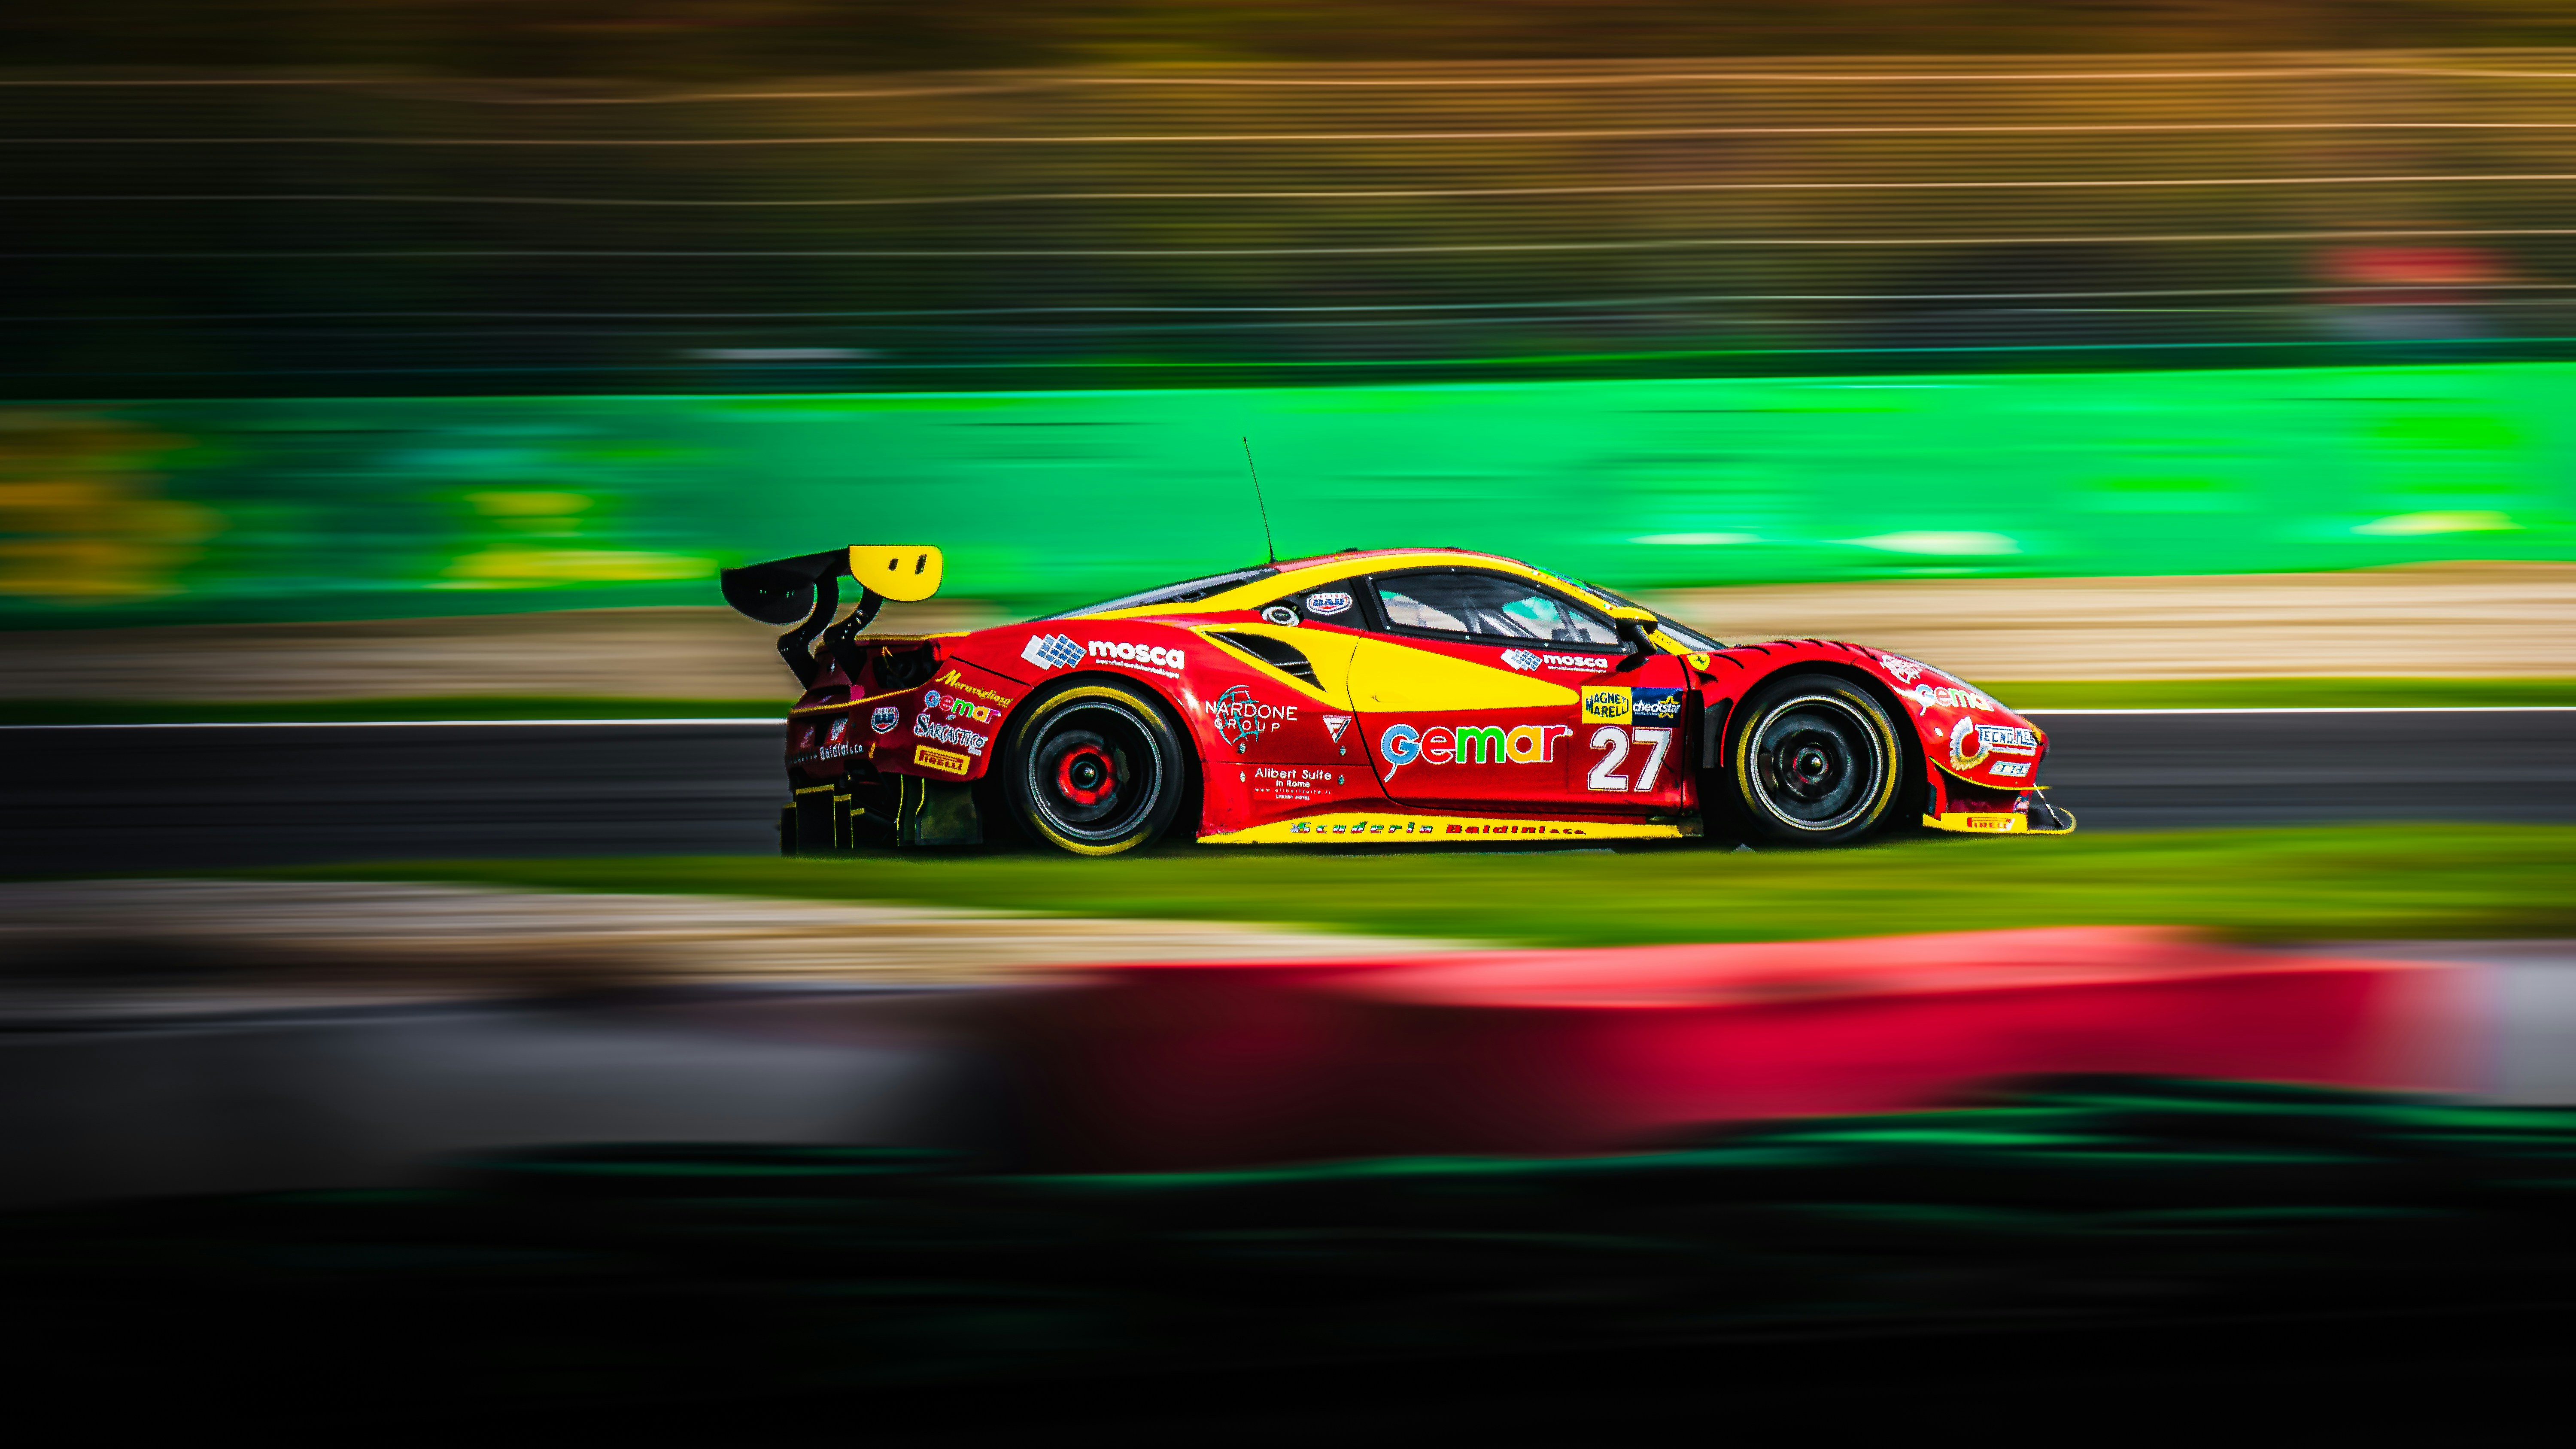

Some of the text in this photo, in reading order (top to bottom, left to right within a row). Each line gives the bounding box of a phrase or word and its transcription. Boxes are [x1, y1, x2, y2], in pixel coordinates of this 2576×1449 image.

[1088, 641, 1185, 670] mosca
[1543, 654, 1608, 668] mosca
[923, 690, 1002, 724] Gemar
[1586, 692, 1629, 707] MAGNETI
[1632, 700, 1681, 713] checkstar
[1205, 700, 1298, 721] NARDONE
[1214, 717, 1280, 732] GROUP
[919, 750, 964, 771] PIRELLI
[1380, 723, 1569, 783] Gemar
[1587, 726, 1672, 792] 27
[1255, 768, 1332, 781] Alibert Suite
[1286, 780, 1310, 788] Rome
[1291, 820, 1434, 834] Scuderia
[1446, 824, 1546, 834] Baldini
[1967, 817, 2012, 829] PIRELL
